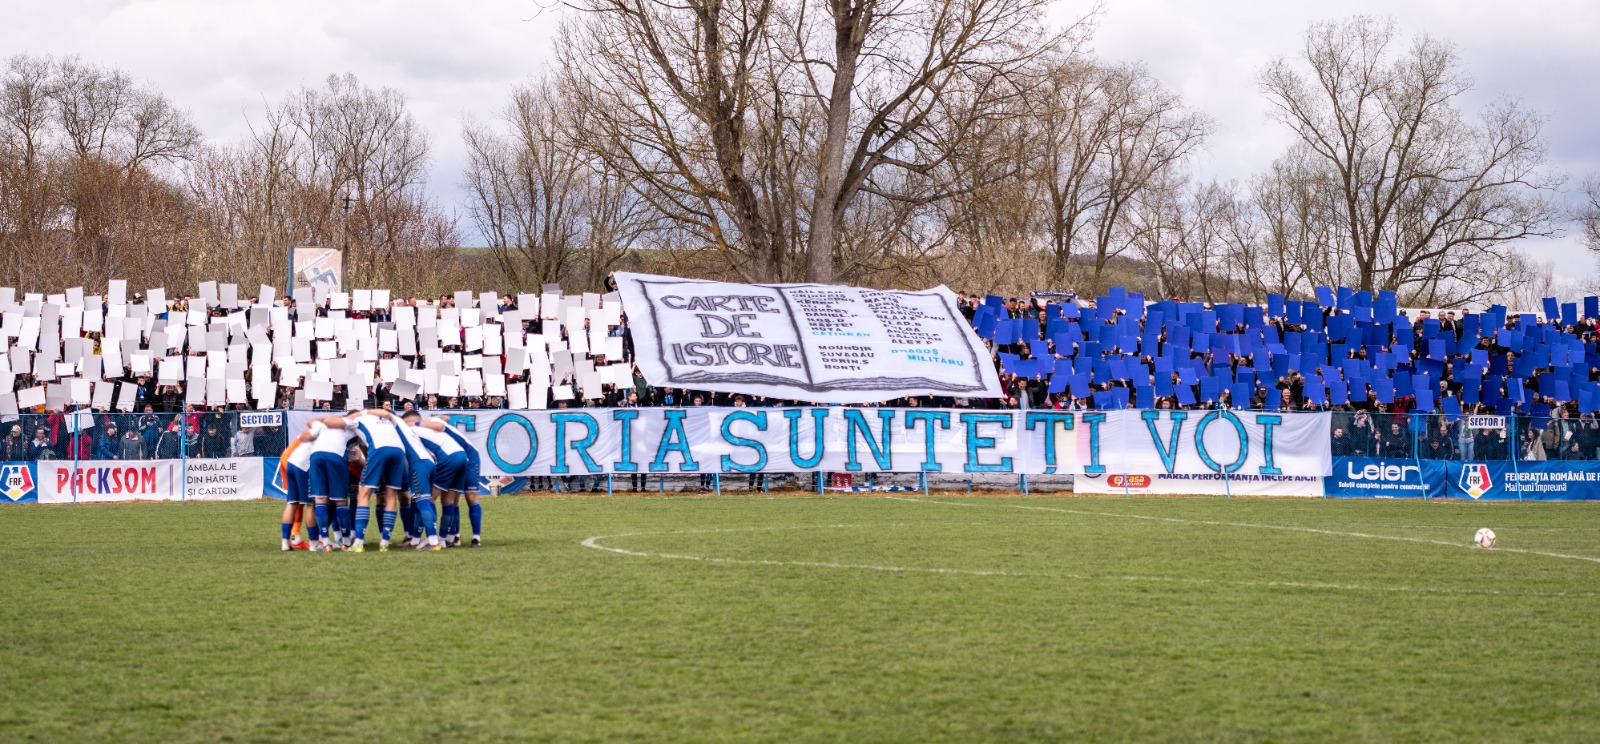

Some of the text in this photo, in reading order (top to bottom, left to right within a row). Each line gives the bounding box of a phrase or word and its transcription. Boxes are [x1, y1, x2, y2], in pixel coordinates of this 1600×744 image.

[660, 295, 780, 313] CARTE
[695, 313, 763, 338] DE
[672, 342, 801, 369] ISTORIE
[241, 414, 281, 425] SECTOR 2
[1469, 417, 1504, 427] SECTOR 1
[1141, 410, 1282, 474] VOI
[187, 463, 237, 472] AMBALAJE
[1347, 461, 1419, 481] Leier
[9, 477, 22, 486] FRF
[57, 467, 156, 496] PACKSOM
[187, 474, 238, 484] DIN HÂRTIE
[1469, 475, 1481, 485] FRF
[1505, 472, 1549, 483] FEDERAȚIA
[1550, 471, 1585, 481] ROMÂNĂ
[1586, 472, 1596, 481] DE
[187, 487, 237, 497] ȘI CARTON
[1505, 483, 1517, 492] Mai
[1535, 483, 1567, 493] împreună
